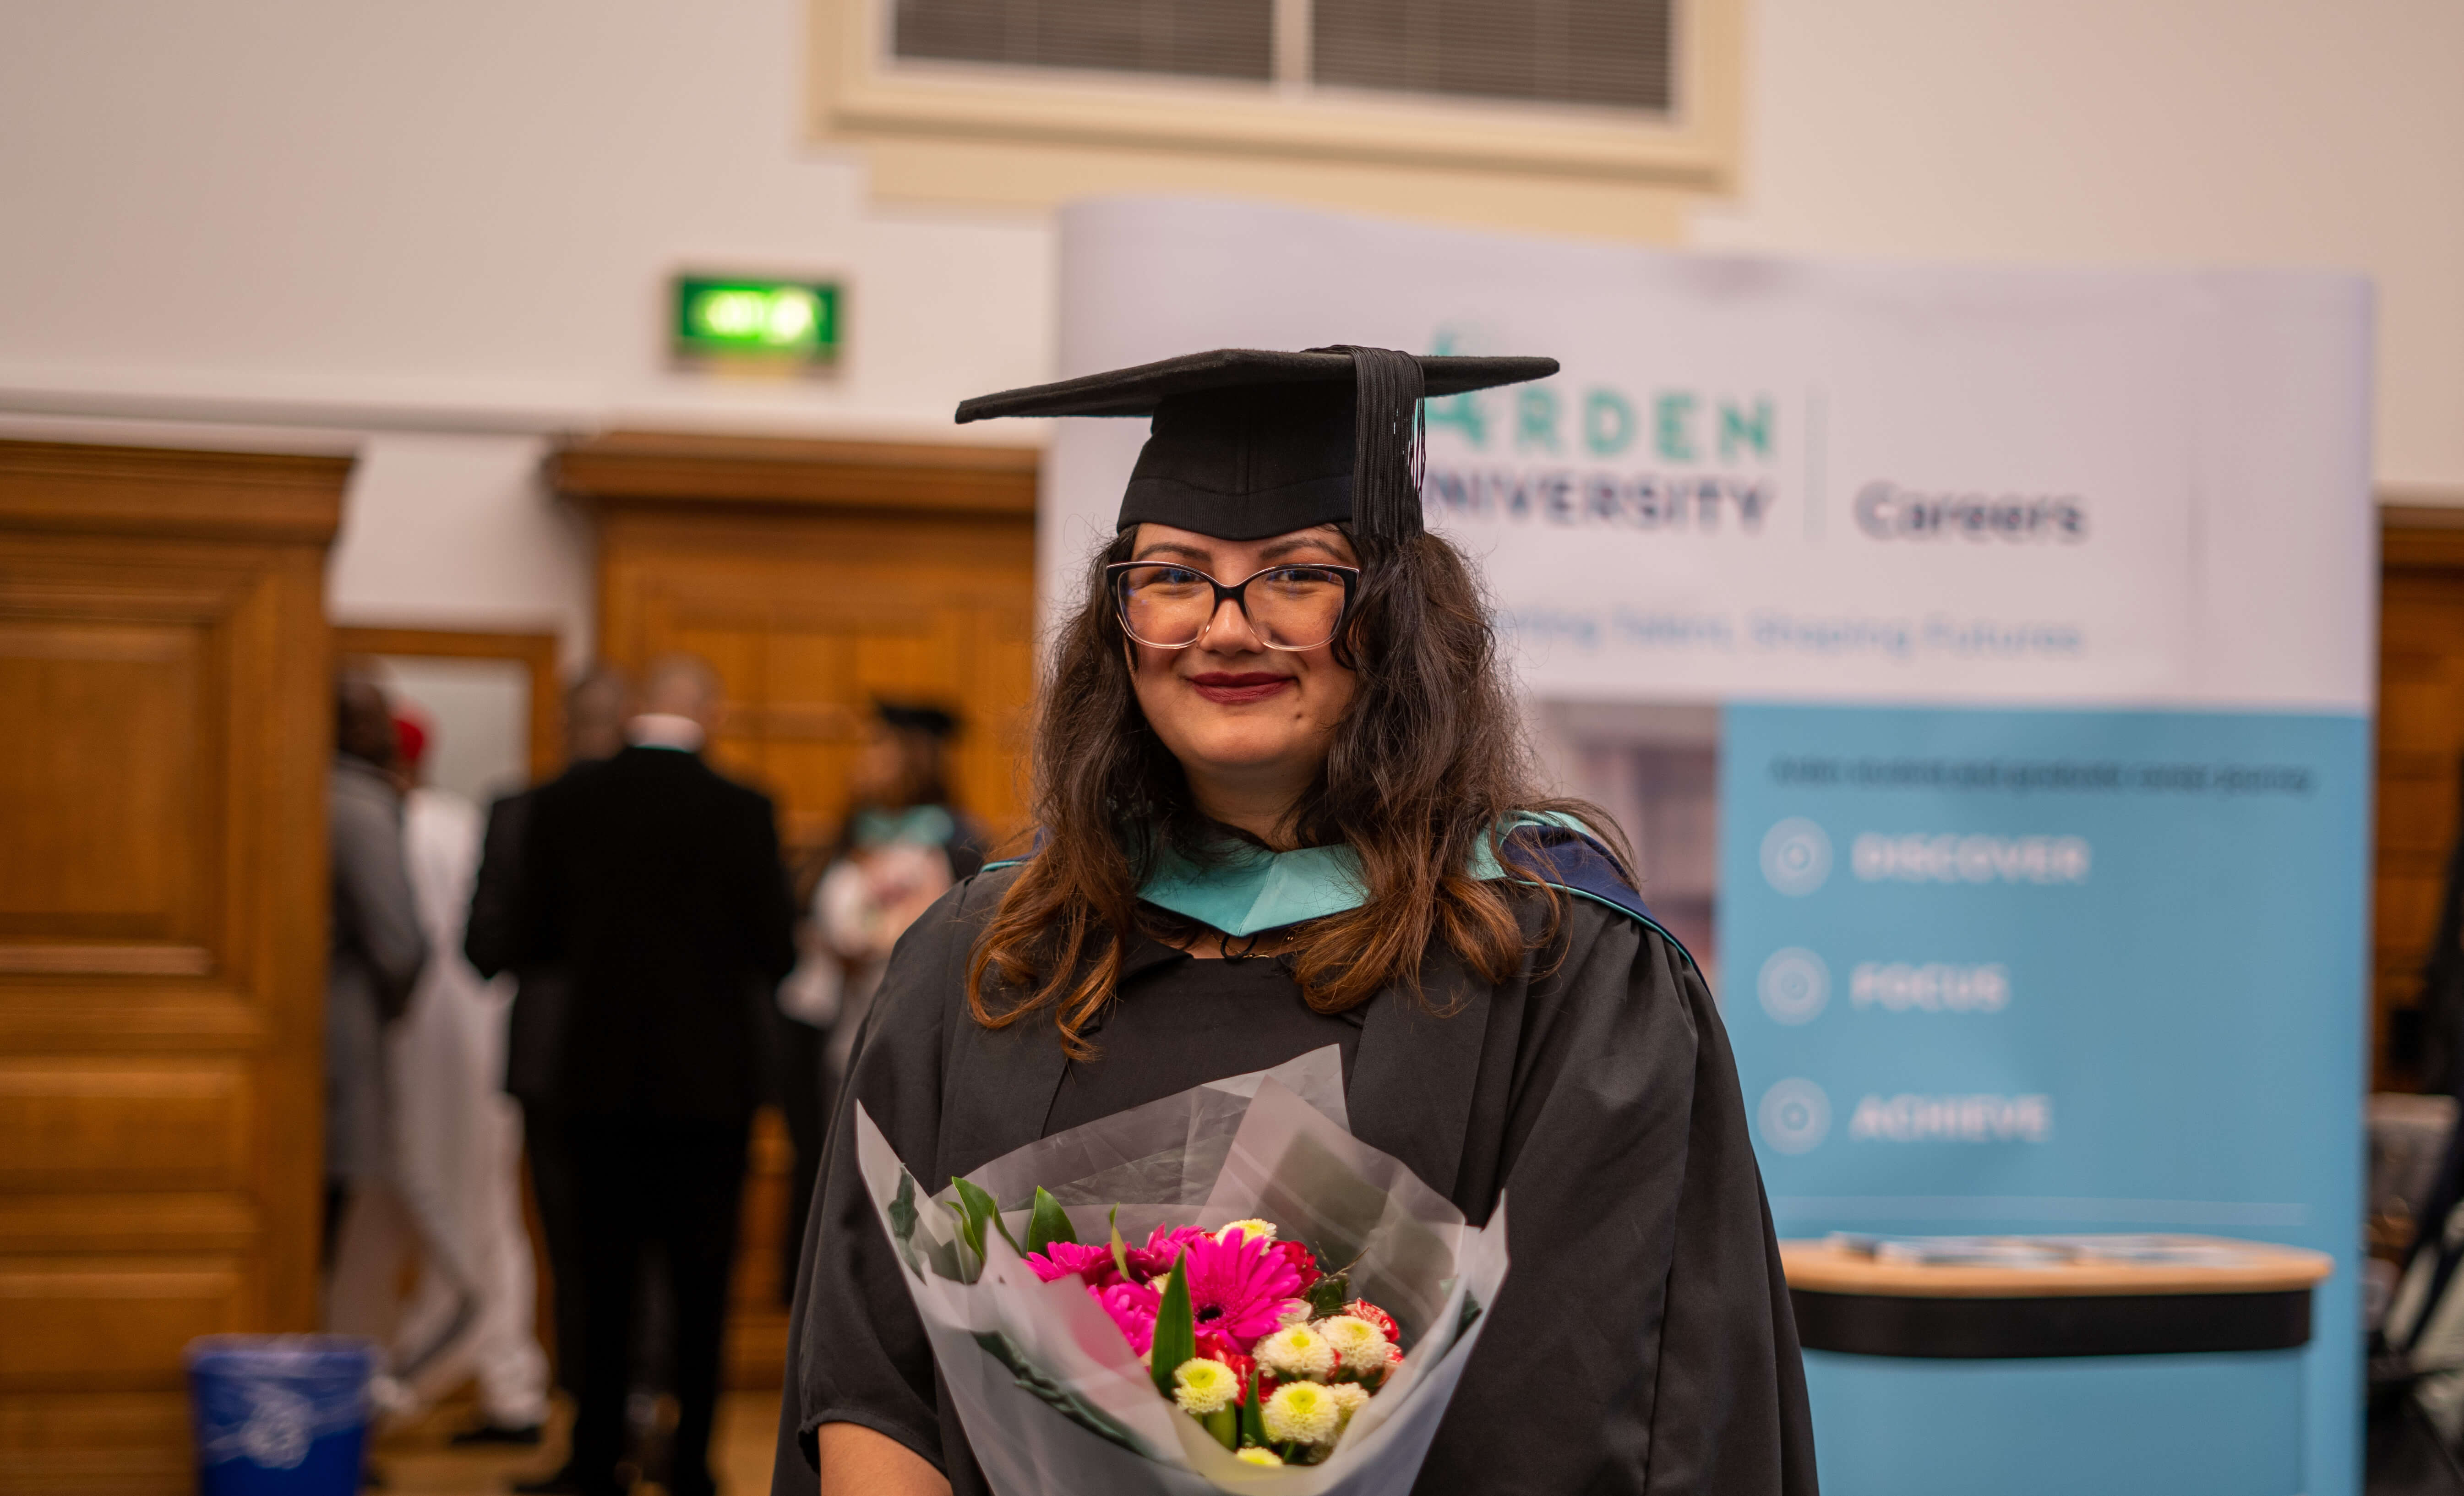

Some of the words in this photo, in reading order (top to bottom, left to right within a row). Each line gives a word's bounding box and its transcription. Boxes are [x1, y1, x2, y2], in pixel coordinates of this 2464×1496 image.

[1423, 466, 1773, 529] NIVERSITY
[1856, 483, 2088, 541] Careers
[1745, 613, 1916, 657] Shaping
[1923, 616, 2086, 657] Futures
[1853, 836, 2090, 880] DISCOVER
[1852, 965, 2009, 1010] FOCUS
[1852, 1096, 2051, 1141] ACHIEVE
